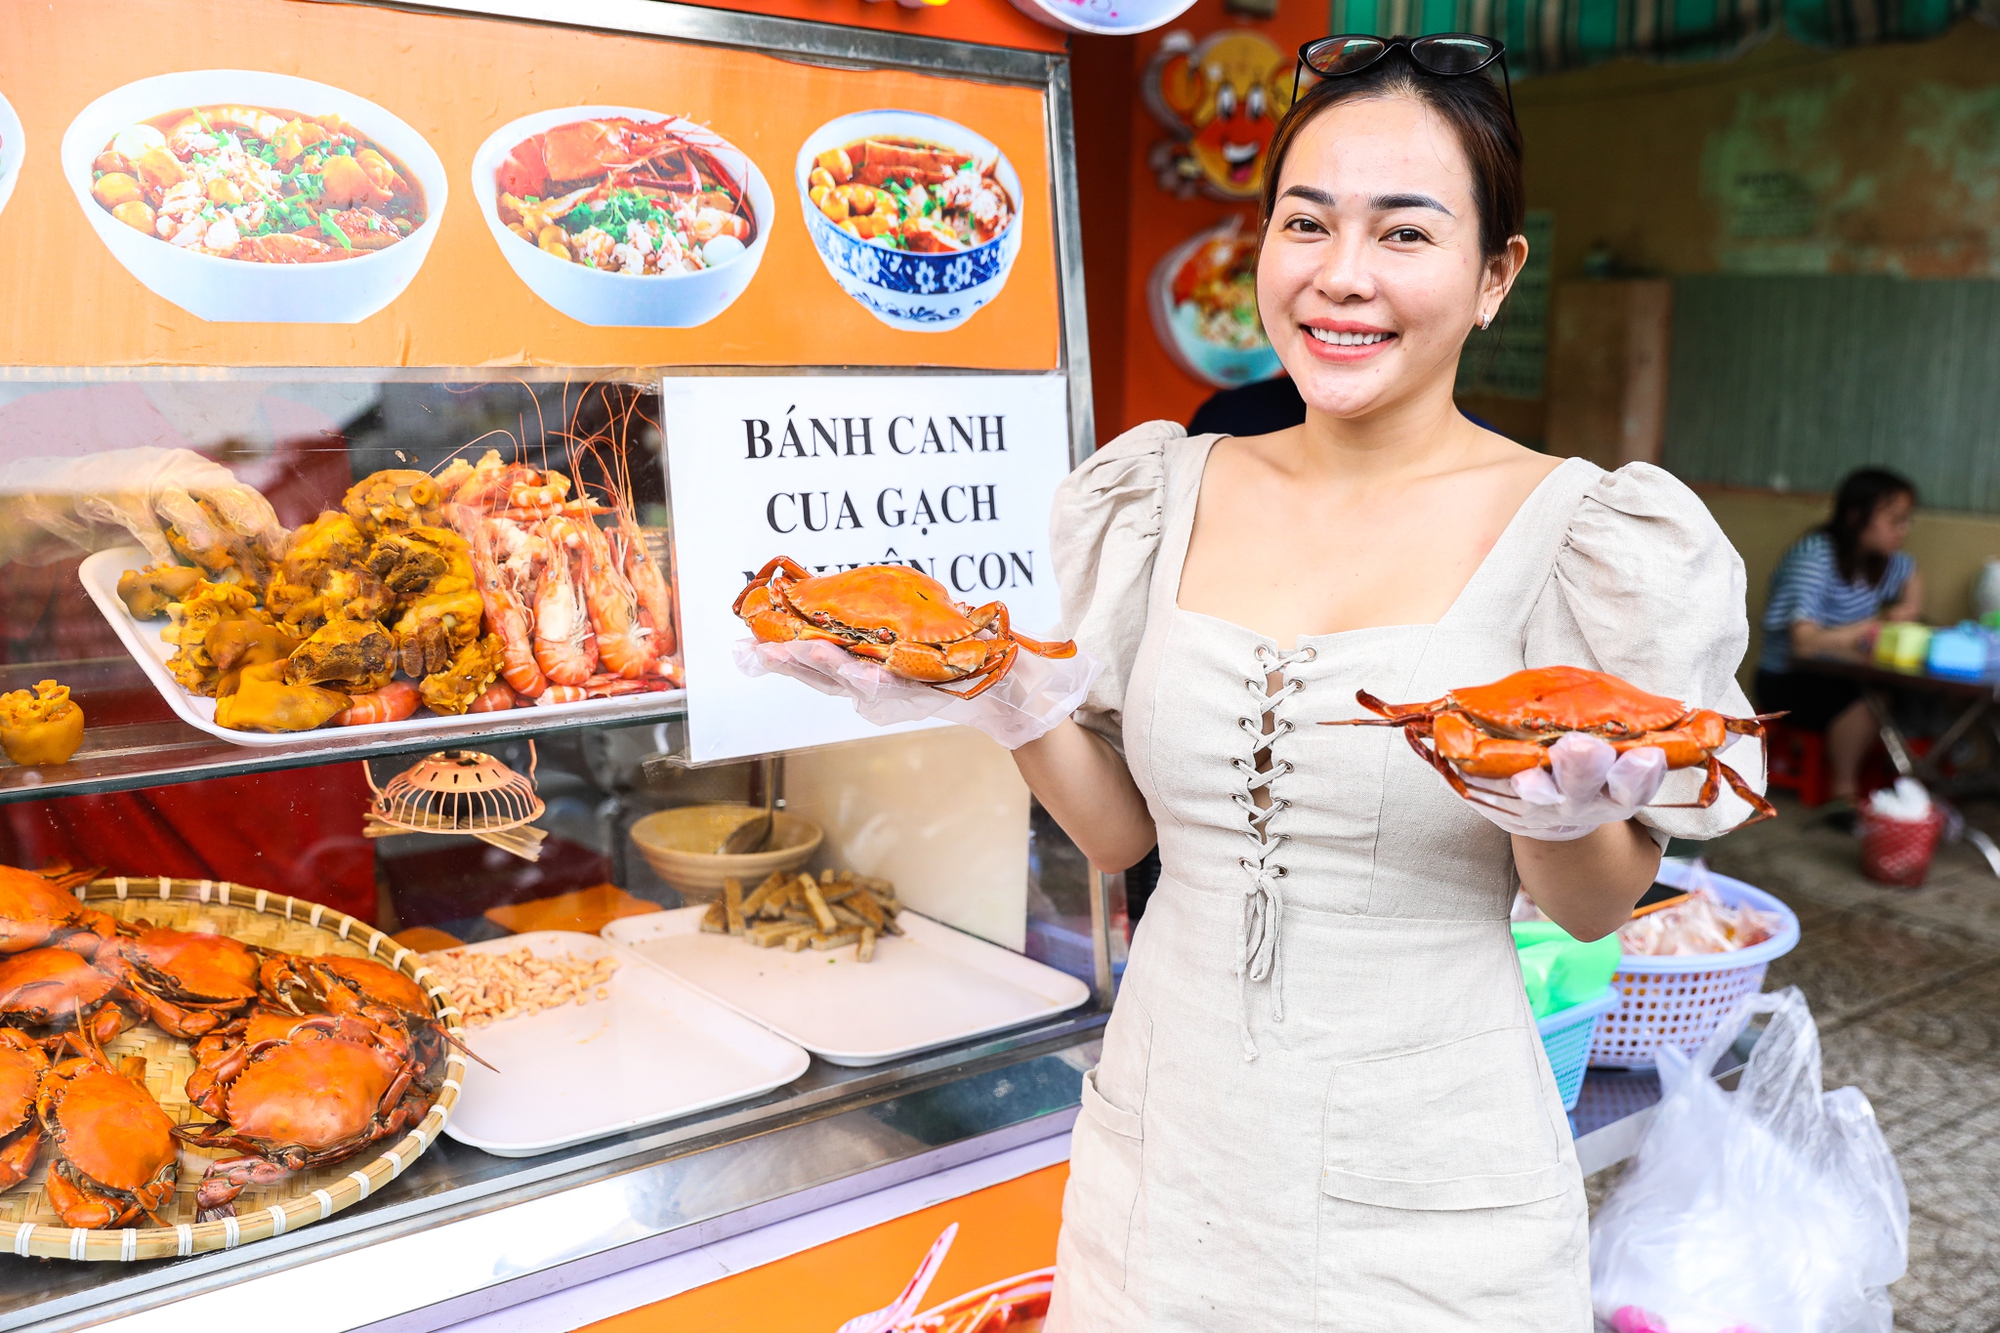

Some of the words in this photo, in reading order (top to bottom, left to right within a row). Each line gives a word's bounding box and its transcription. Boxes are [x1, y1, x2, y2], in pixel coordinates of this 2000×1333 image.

[742, 404, 874, 459] BÁNH
[888, 414, 1006, 455] CANH
[766, 491, 864, 534] CUA
[876, 484, 998, 536] GẠCH
[950, 550, 1034, 593] CON
